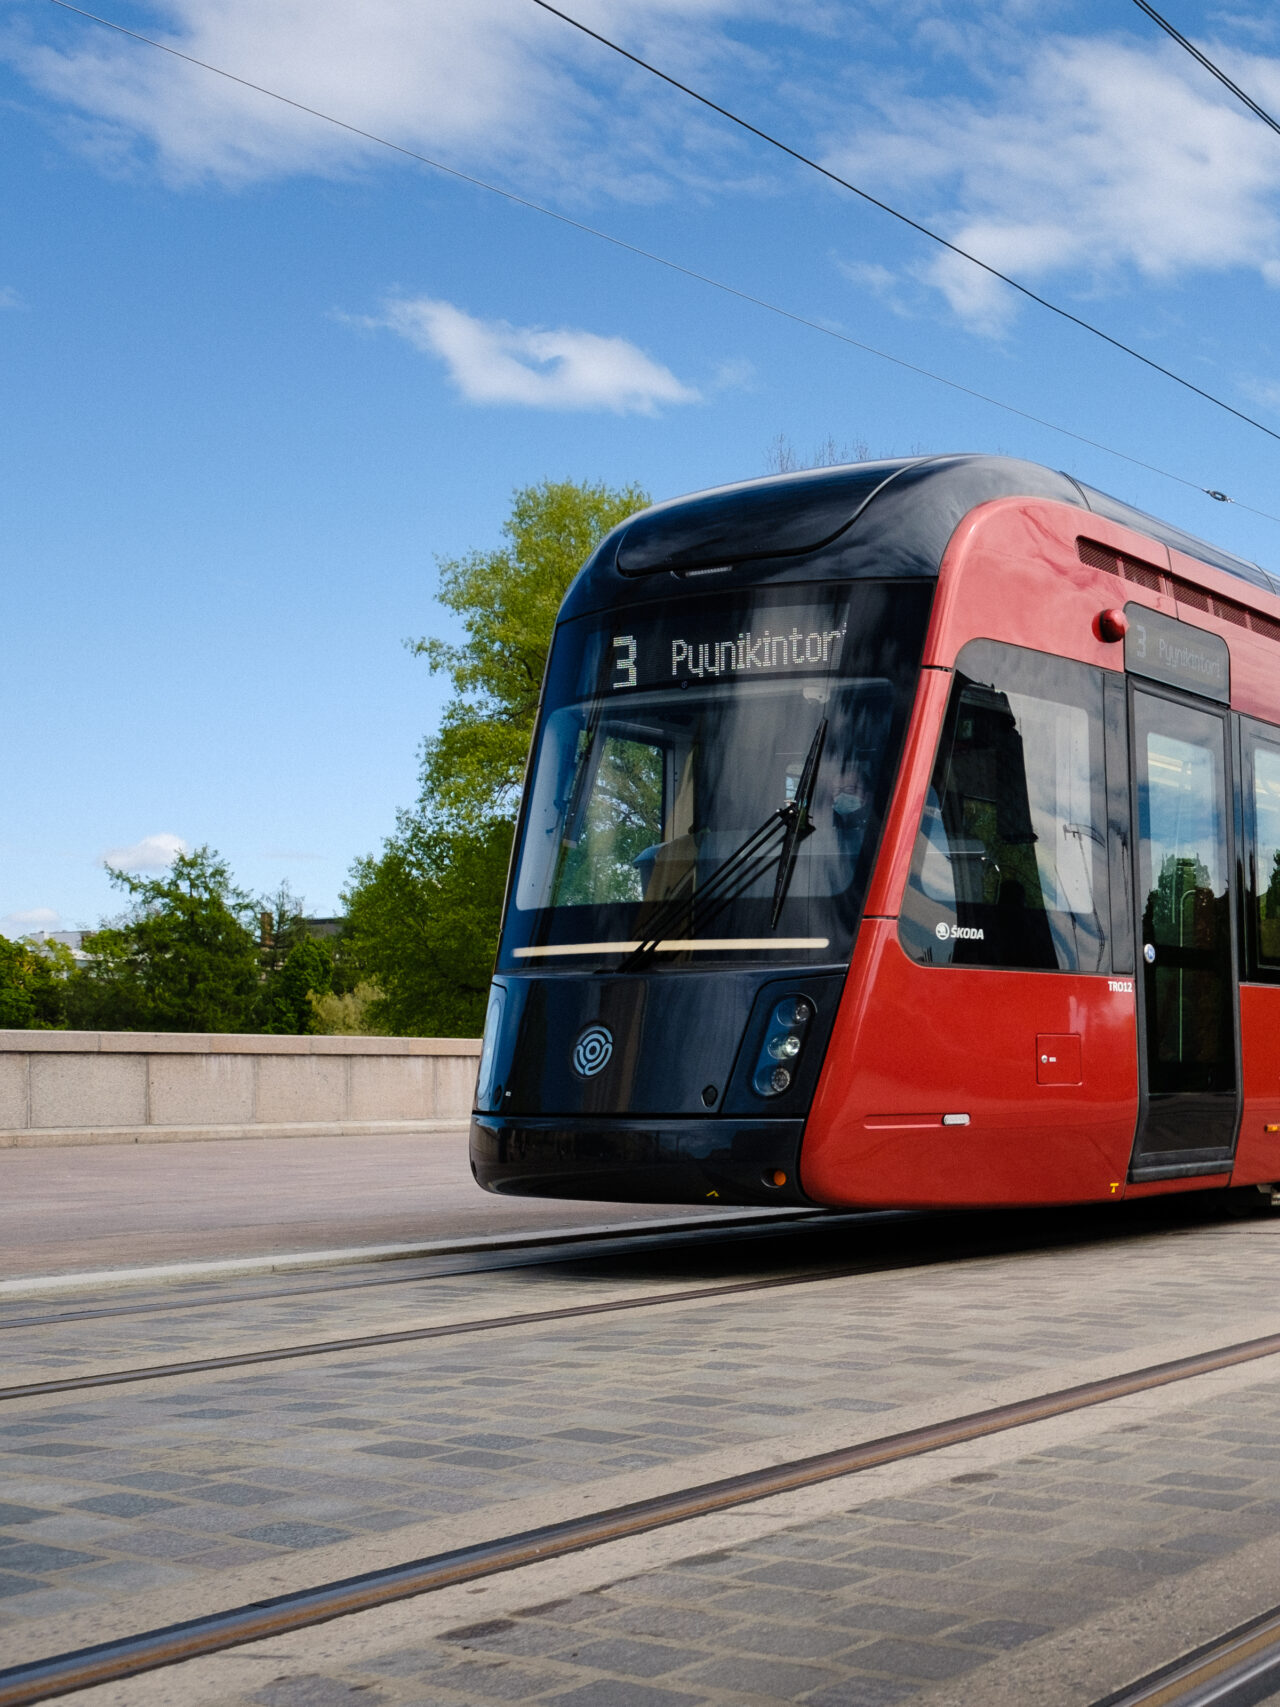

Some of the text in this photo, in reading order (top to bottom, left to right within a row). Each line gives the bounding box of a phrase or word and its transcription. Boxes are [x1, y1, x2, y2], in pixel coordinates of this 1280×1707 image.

[1136, 625, 1147, 658] 3
[613, 635, 637, 688] 3
[950, 924, 984, 940] ŠKODA
